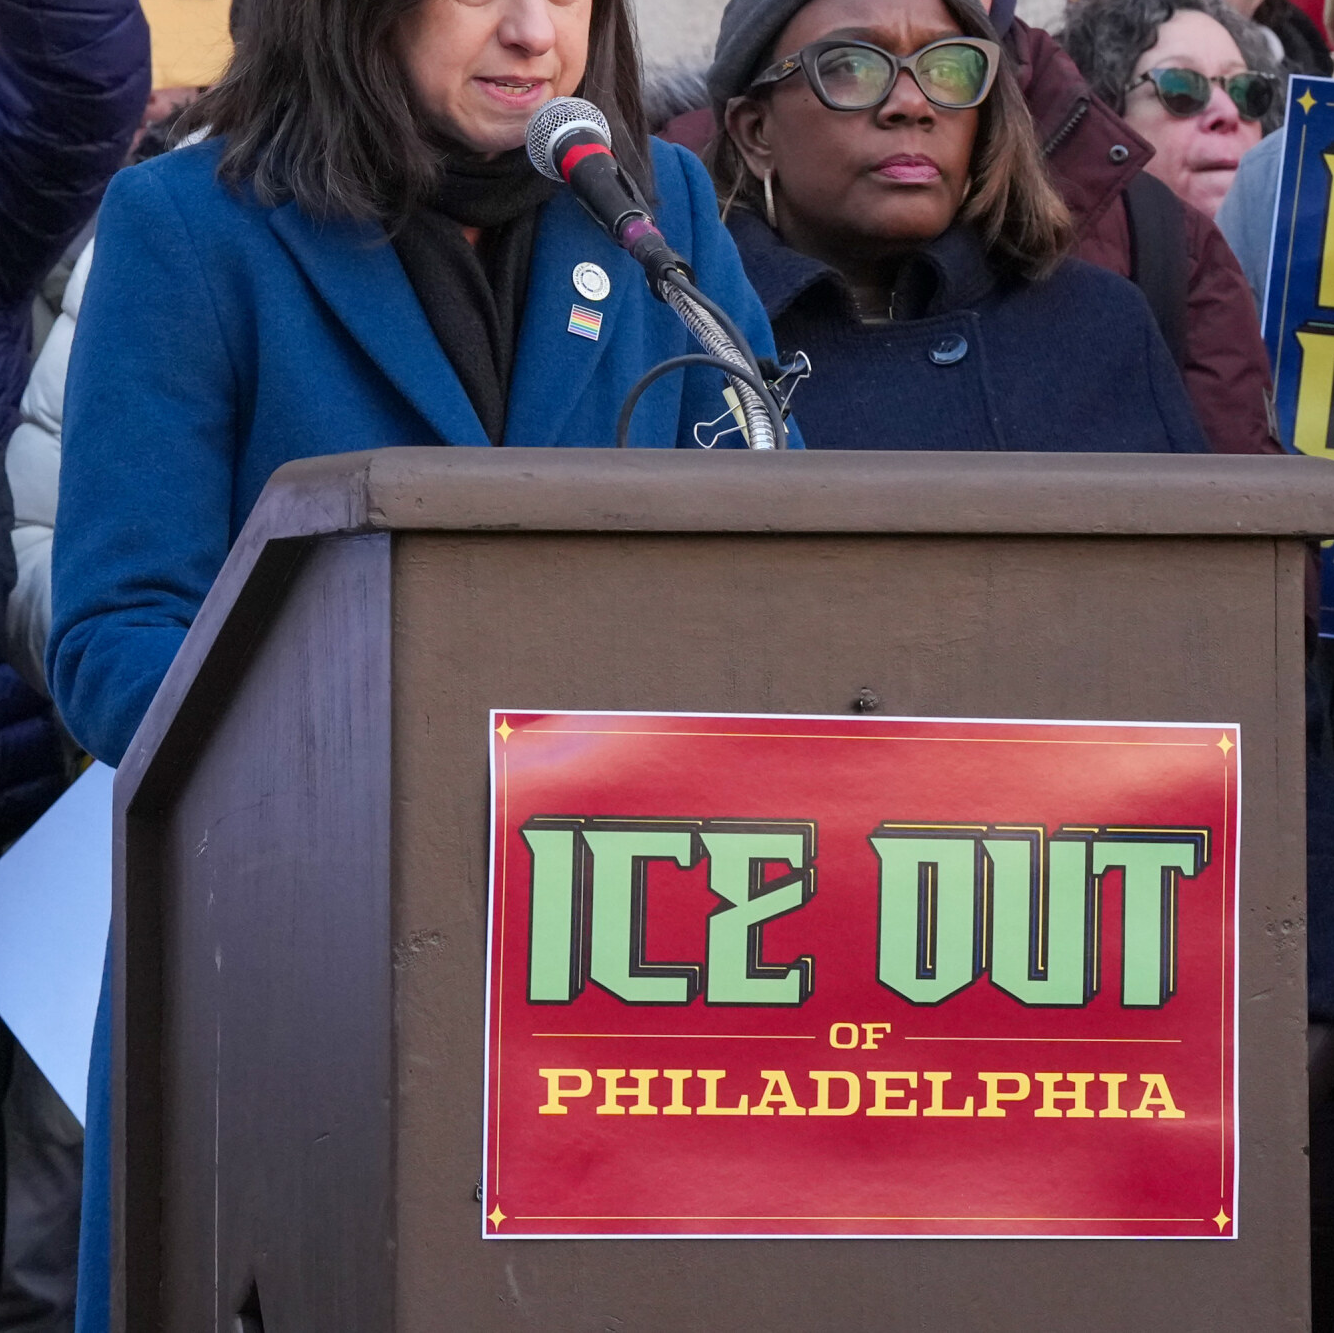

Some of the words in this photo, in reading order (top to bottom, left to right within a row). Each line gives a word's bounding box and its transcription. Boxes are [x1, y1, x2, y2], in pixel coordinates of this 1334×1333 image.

[519, 815, 818, 1007] ICE
[868, 821, 1211, 1009] OUT
[828, 1021, 892, 1051] OF
[537, 1067, 1187, 1119] PHILADELPHIA
